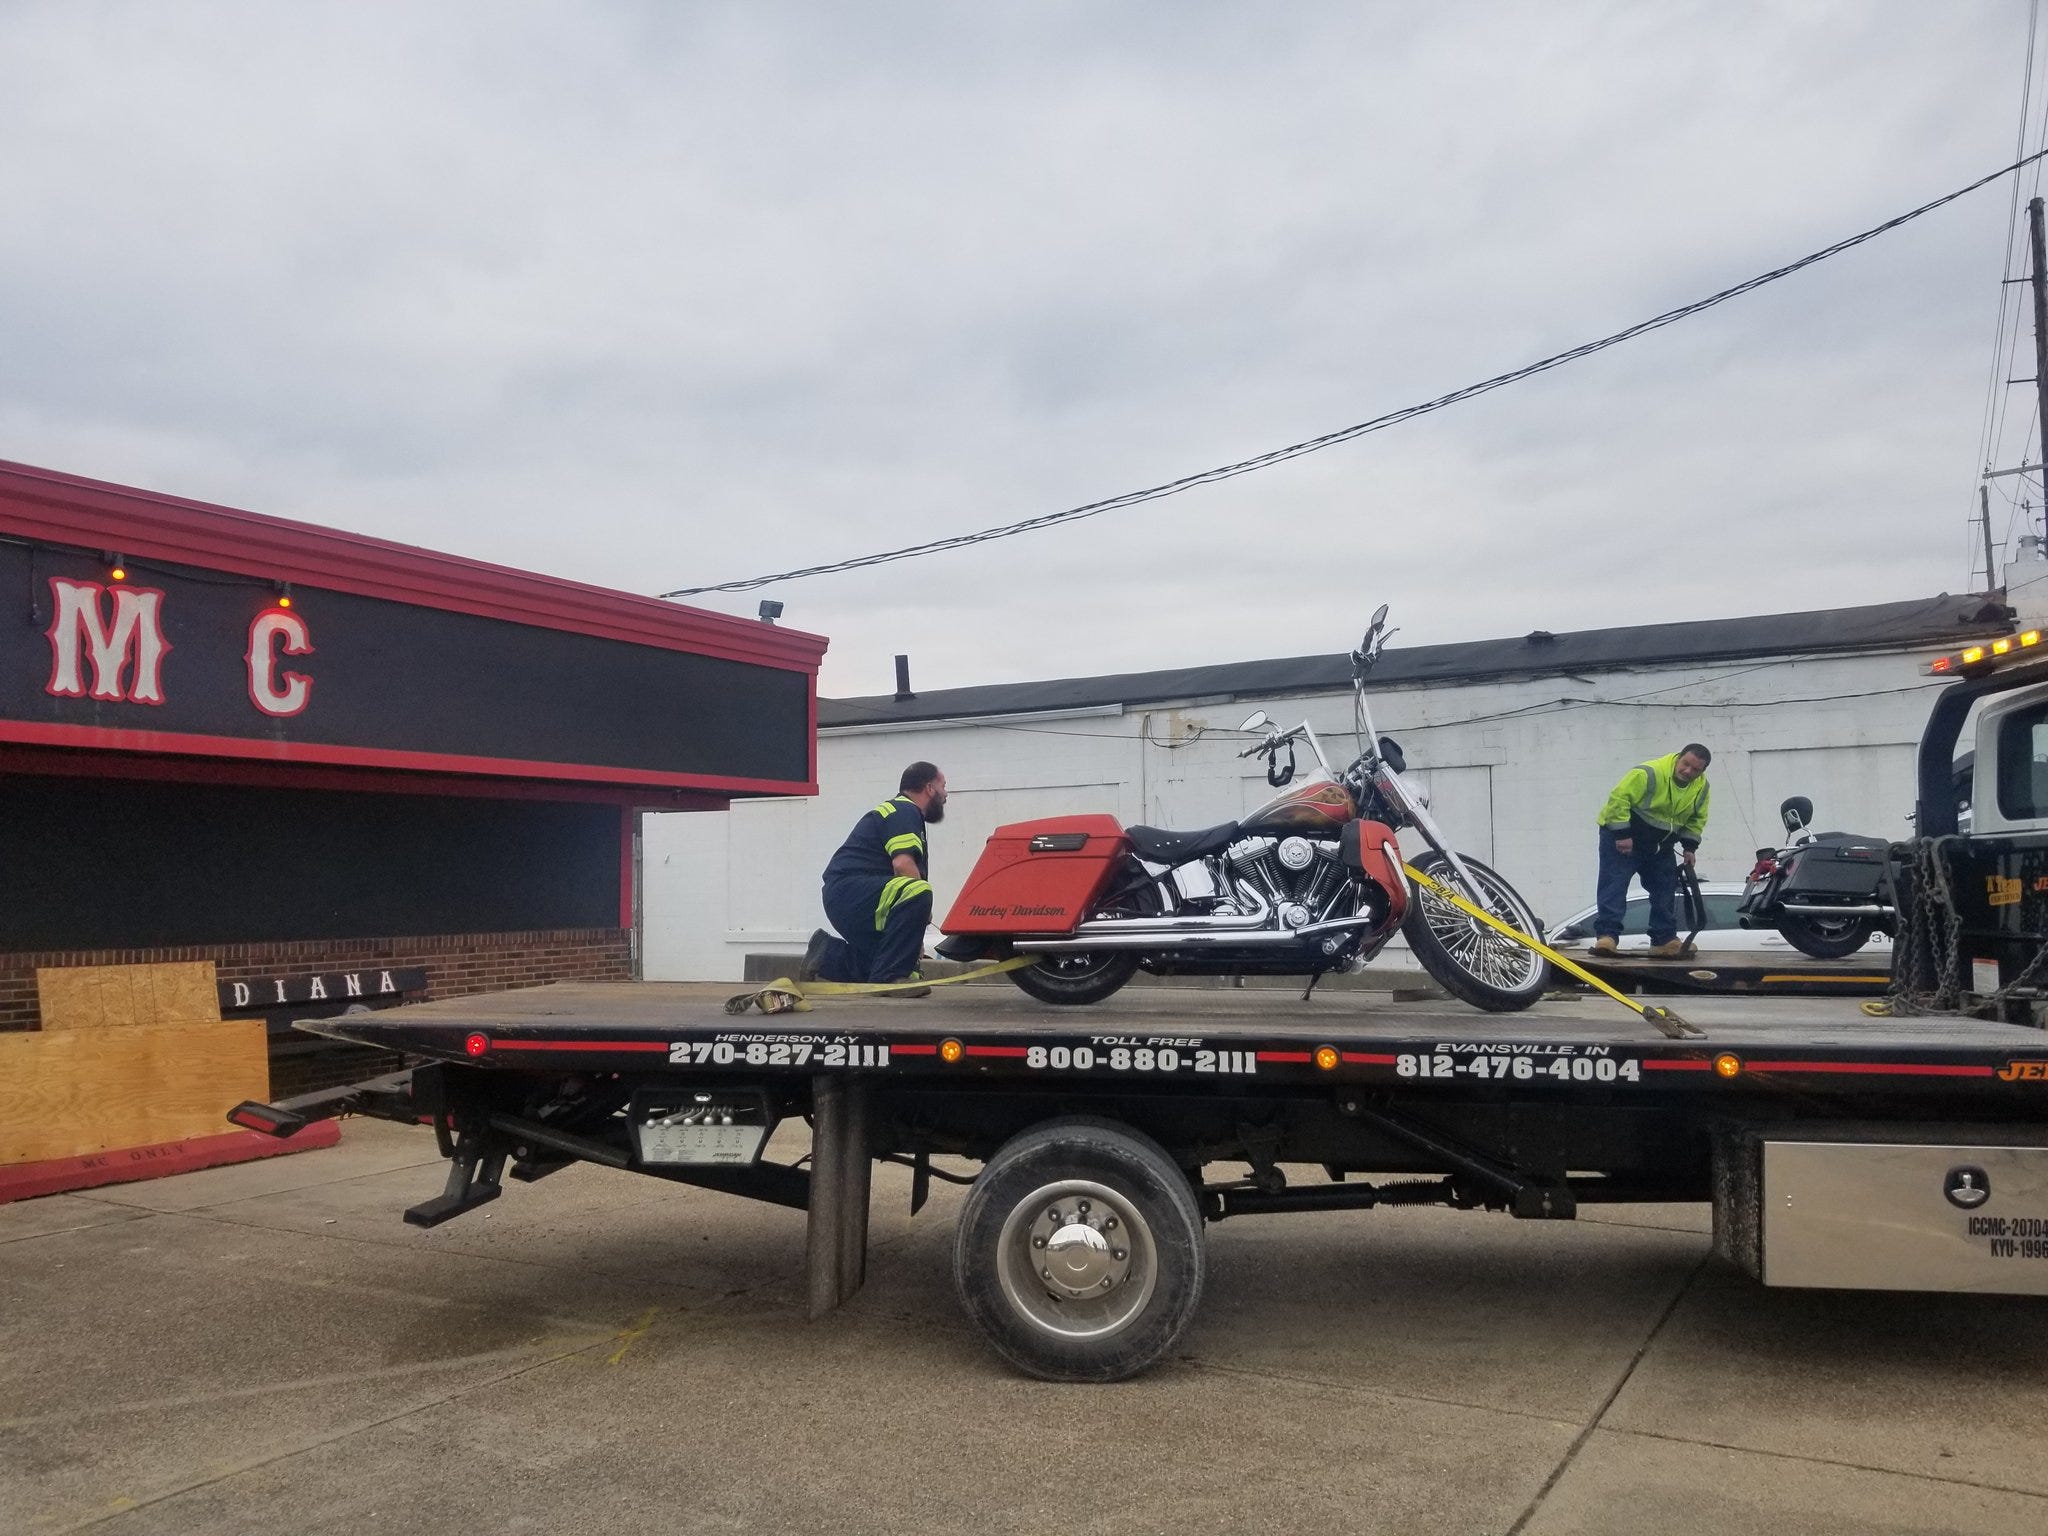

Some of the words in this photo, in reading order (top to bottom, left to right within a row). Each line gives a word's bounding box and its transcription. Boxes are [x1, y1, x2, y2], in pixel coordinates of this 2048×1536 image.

[233, 971, 395, 1006] DIANA
[715, 1034, 829, 1044] HENDERSON,
[834, 1036, 859, 1044] KY
[1091, 1036, 1141, 1045] TOLL
[1146, 1037, 1203, 1047] FREE
[669, 1042, 890, 1067] 270-827-2111
[1026, 1046, 1257, 1073] 800-880-2111
[1584, 1046, 1610, 1055] IN
[1396, 1054, 1640, 1081] 812-476-4004
[1997, 1062, 2048, 1081] JE
